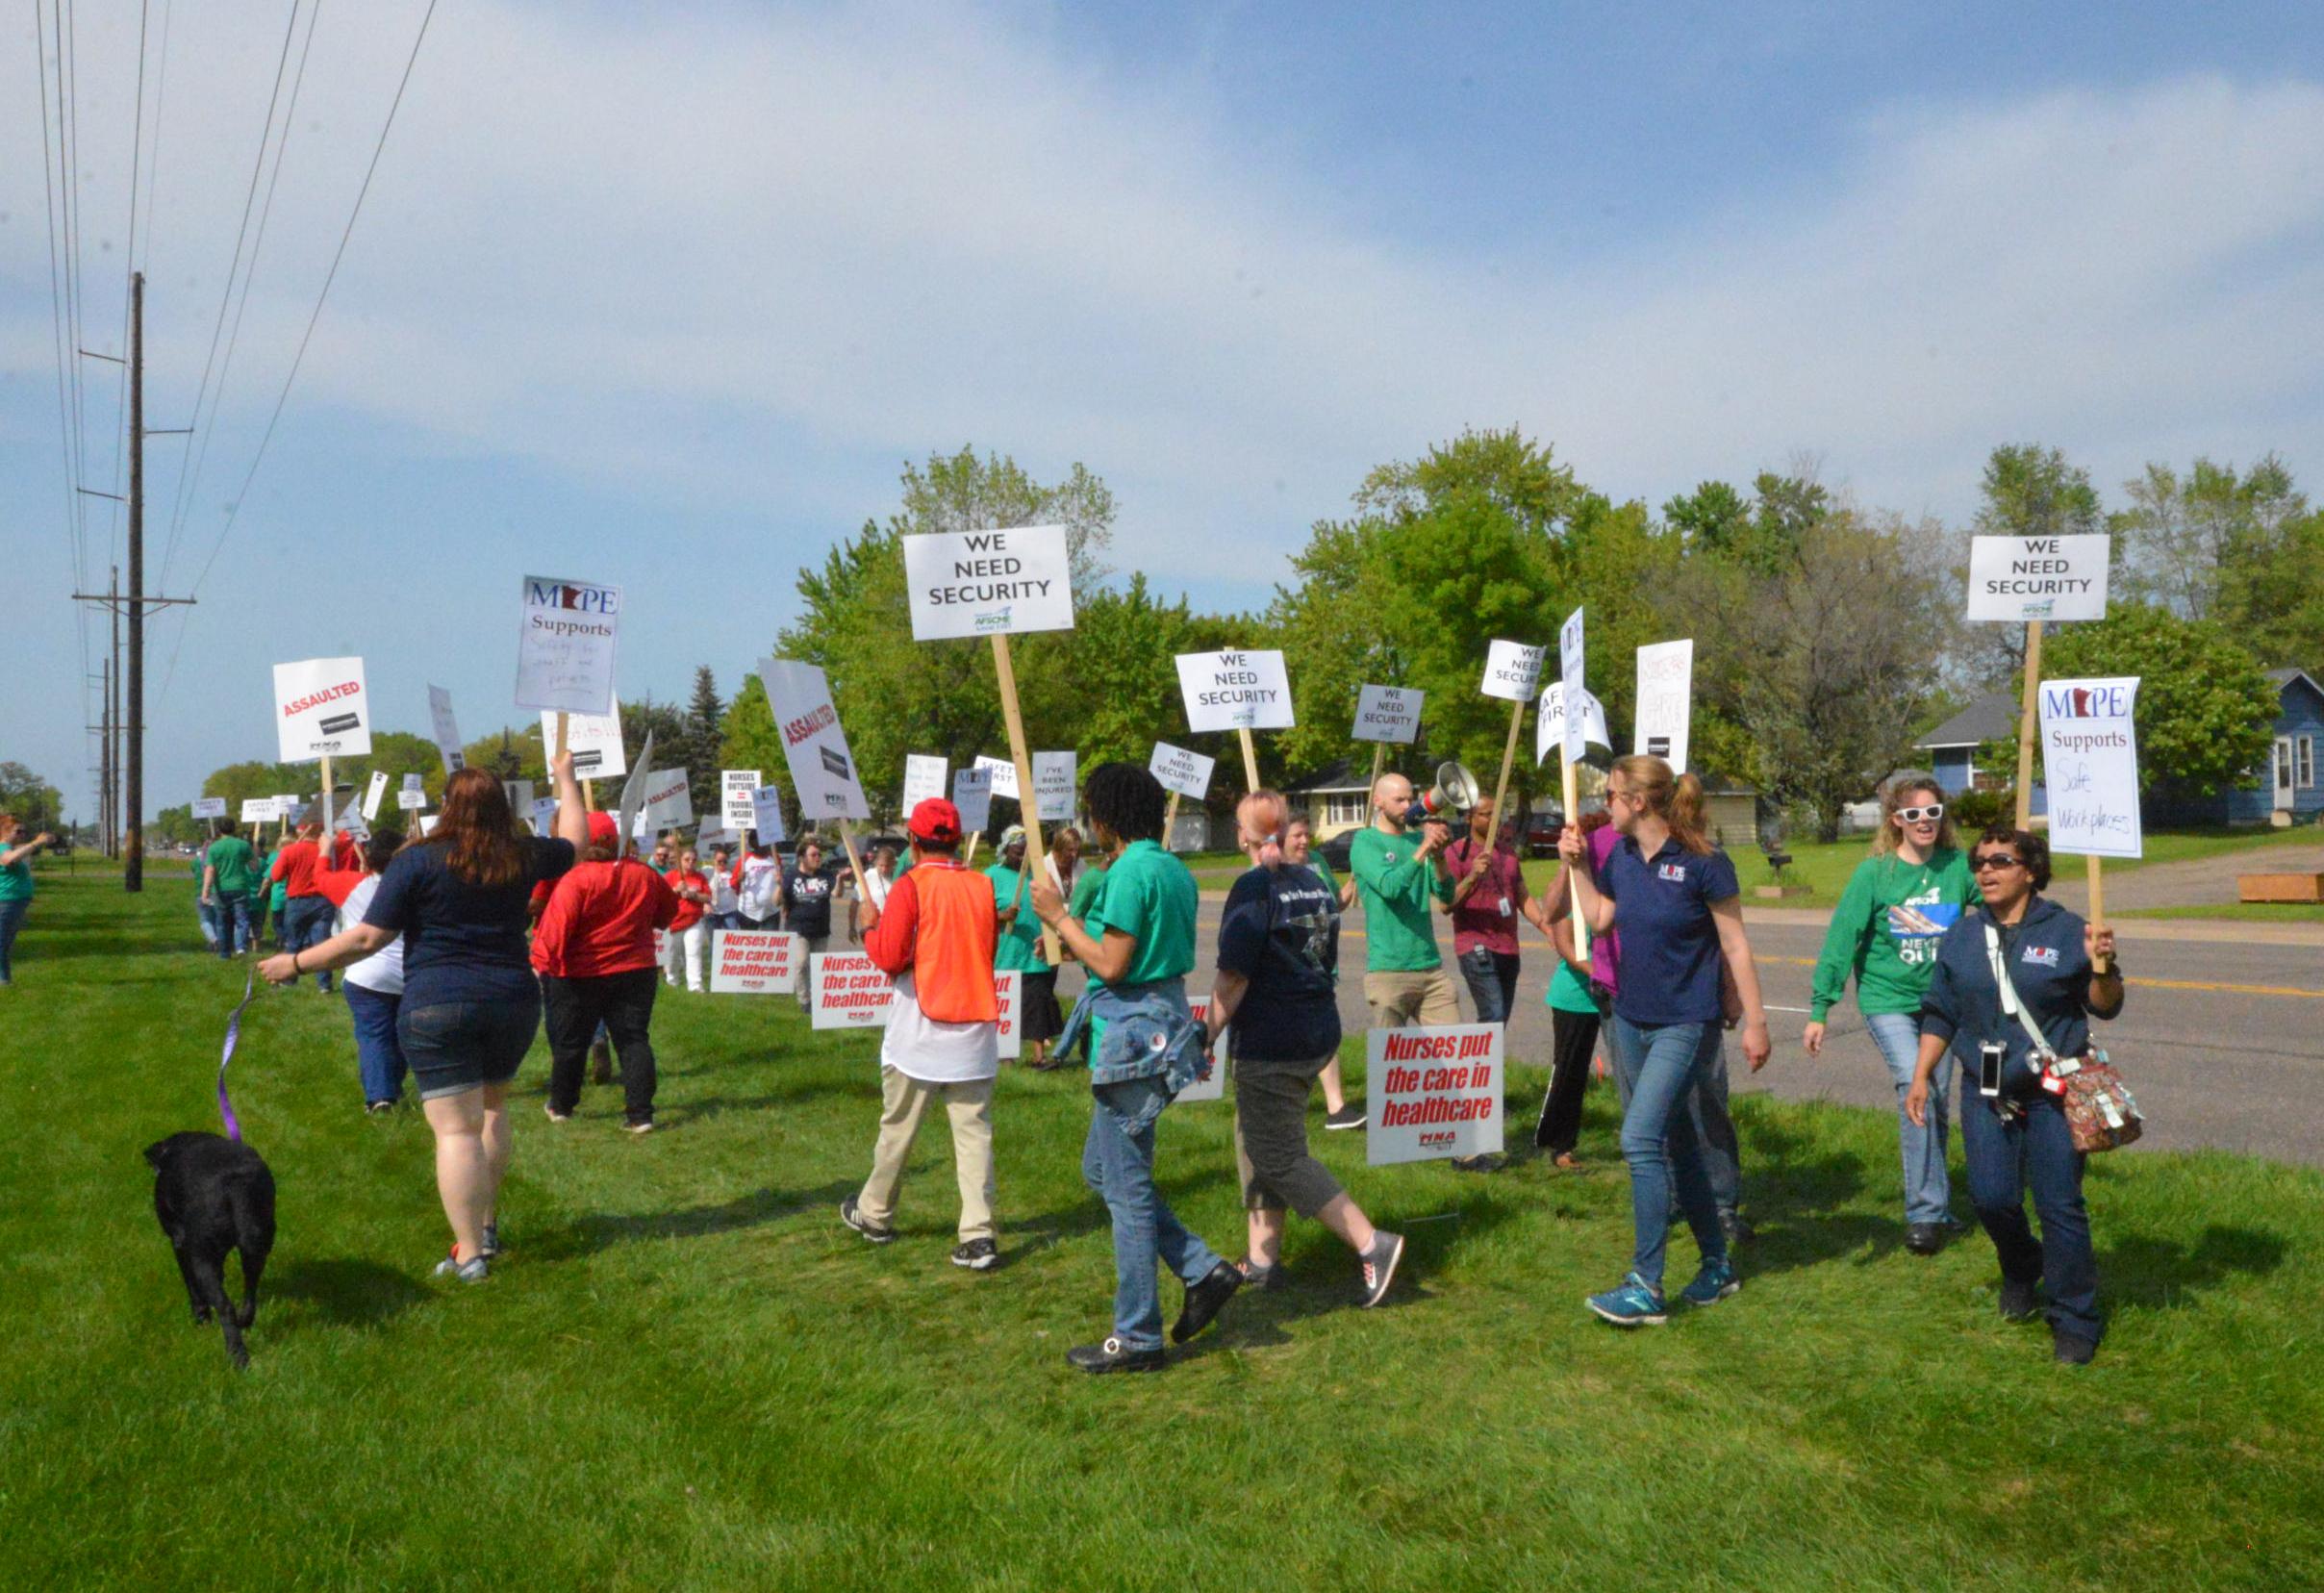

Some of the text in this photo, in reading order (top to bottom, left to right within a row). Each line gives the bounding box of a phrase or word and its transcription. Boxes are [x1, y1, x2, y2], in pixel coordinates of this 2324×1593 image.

[965, 534, 1006, 552] WE
[2025, 540, 2059, 554] WE
[954, 558, 1022, 578] NEED
[2012, 560, 2069, 574] NEED
[929, 580, 1050, 605] SECURITY
[1986, 578, 2092, 594] SECURITY
[531, 582, 617, 615] MPE
[531, 615, 613, 637] Supports
[1219, 654, 1247, 667] WE
[1521, 647, 1540, 659] WE
[1215, 672, 1258, 686] NEED
[284, 681, 361, 718] ASSAULTED
[1199, 690, 1277, 705] SECURITY
[1385, 689, 1402, 699] WE
[1377, 701, 1404, 713] NEED
[2046, 687, 2127, 720] MPE
[784, 704, 836, 746] ASSAULTED
[1363, 713, 1412, 726] SECURITY
[2052, 730, 2127, 753] Supports
[1177, 750, 1193, 762] WE
[982, 762, 1015, 775] SAFET
[1169, 758, 1195, 771] NEED
[1157, 765, 1201, 784] SECURITY
[2056, 758, 2092, 794] Safe
[648, 782, 687, 805] ASSAULTED
[1035, 786, 1072, 796] INJURED
[727, 800, 753, 809] TROUBL
[731, 810, 753, 819] INSIDE
[723, 933, 790, 948] Nurses put
[1902, 938, 1939, 949] NEVE
[723, 948, 788, 961] the care in
[1900, 949, 1936, 966] QUI
[720, 964, 789, 977] healthcare
[822, 956, 872, 972] Nurses
[823, 974, 847, 990] the
[849, 974, 882, 989] care
[821, 991, 894, 1008] healthcar
[1383, 1031, 1494, 1061] Nurses put
[1384, 1062, 1491, 1093] the care in
[1381, 1097, 1493, 1127] healthcare
